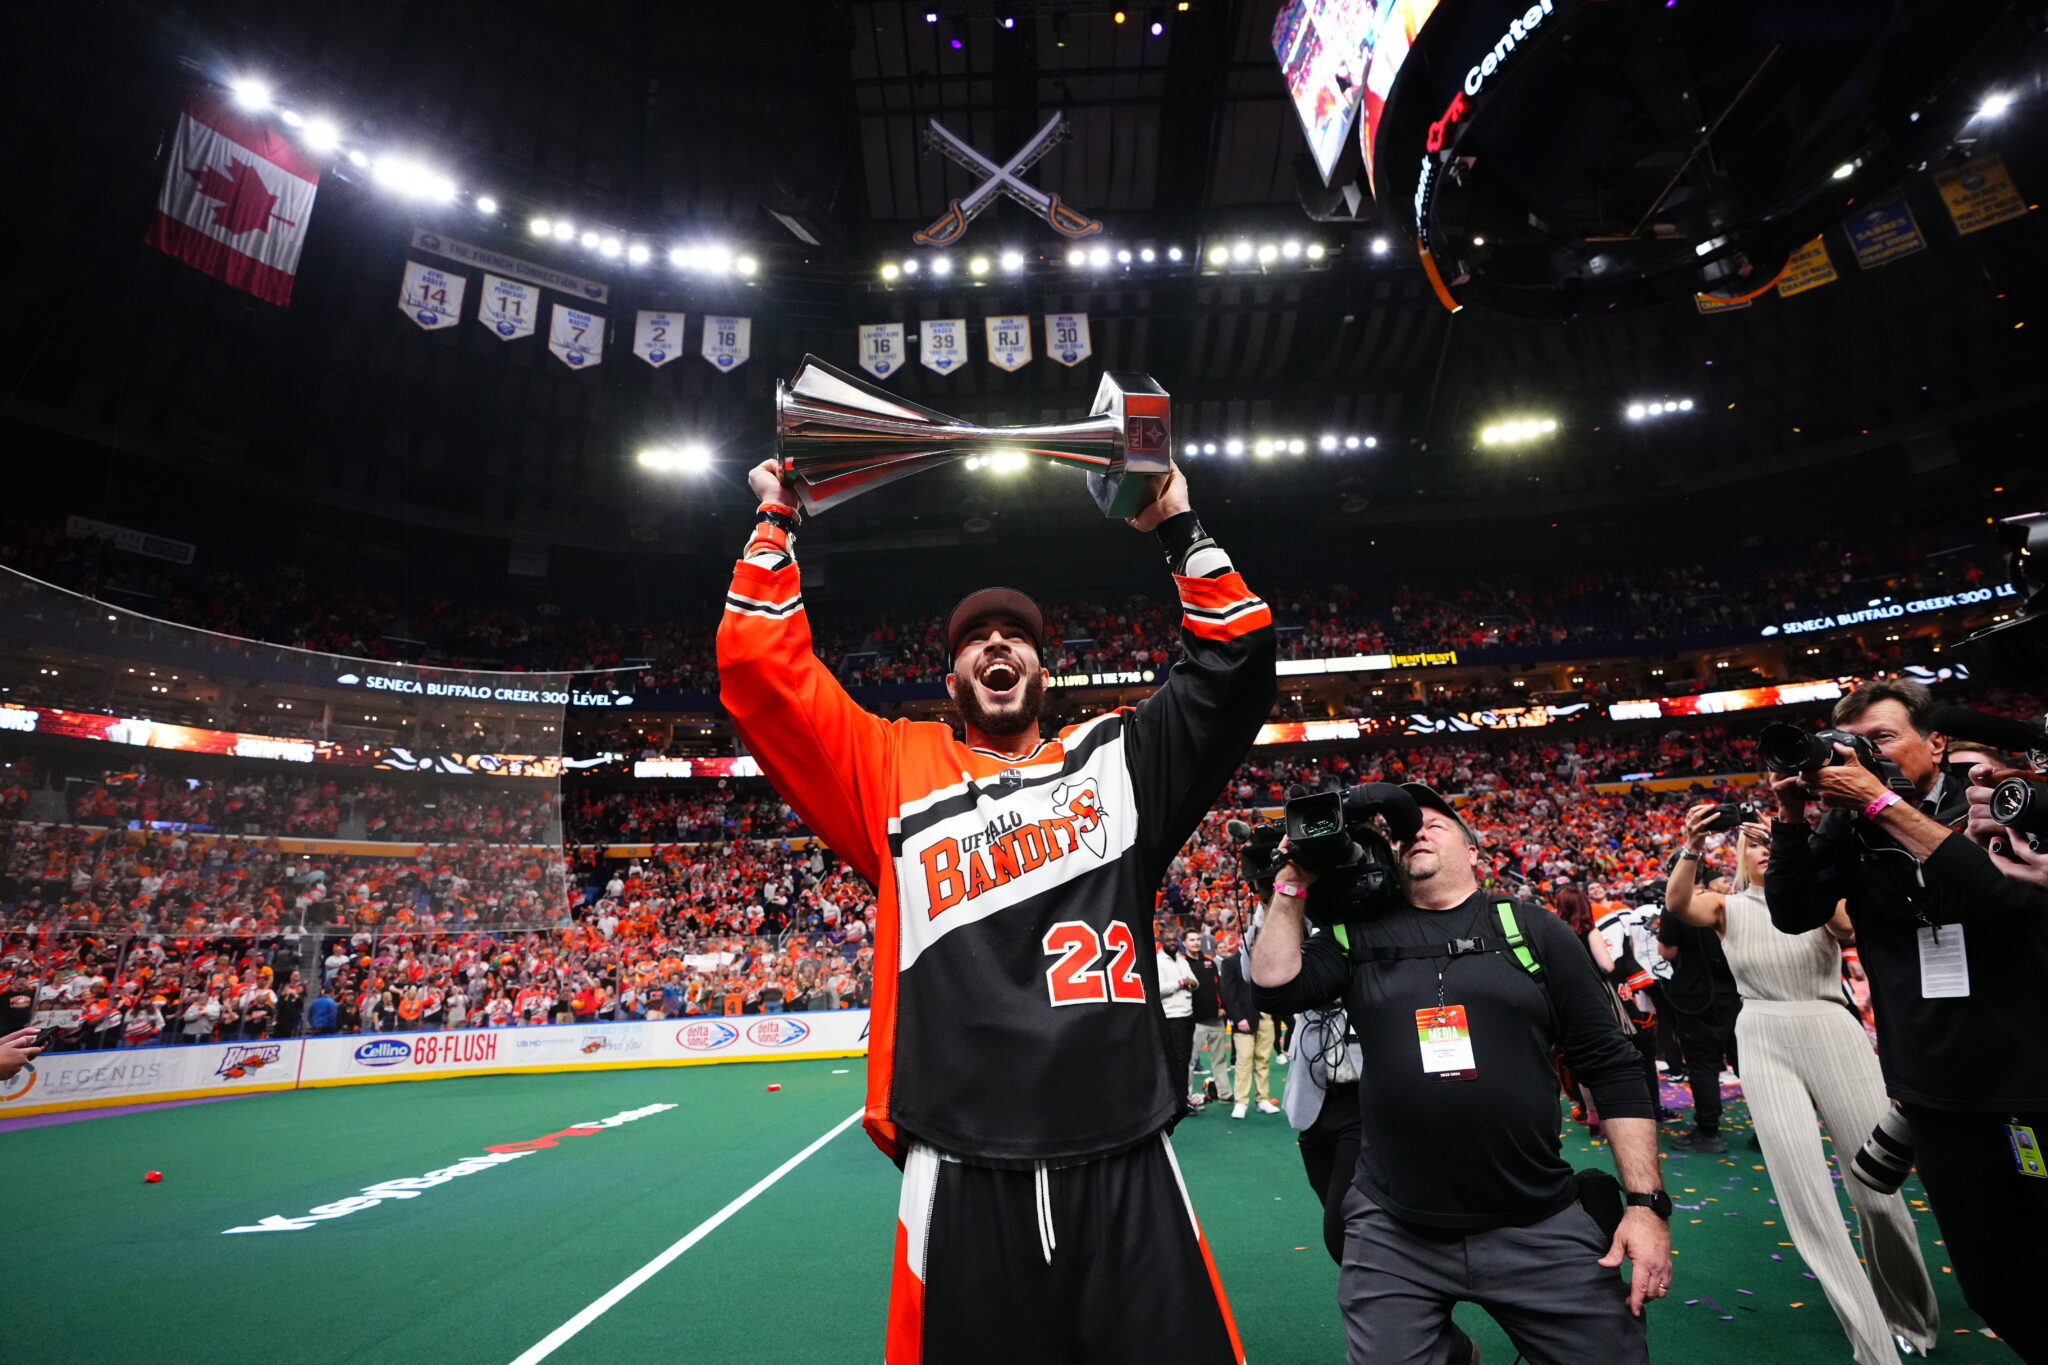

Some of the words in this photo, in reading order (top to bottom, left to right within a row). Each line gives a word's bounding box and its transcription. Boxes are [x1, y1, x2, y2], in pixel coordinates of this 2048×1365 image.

[472, 251, 514, 272] FRENCH
[516, 264, 579, 290] CONNECTION
[418, 284, 447, 306] 14
[497, 296, 522, 317] 11
[571, 326, 586, 343] 7
[652, 326, 666, 343] 2
[717, 331, 736, 347] 18
[932, 334, 955, 350] 39
[998, 331, 1020, 346] RJ
[1056, 328, 1078, 344] 30
[872, 338, 891, 354] 16
[1783, 618, 1836, 635] SENECA
[1836, 604, 1905, 626] BUFFALO
[1906, 595, 1957, 614] CREEK
[1957, 587, 1992, 606] 300
[1064, 674, 1089, 687] LOVED
[1092, 674, 1102, 685] IN
[1102, 672, 1118, 684] THE
[1118, 671, 1141, 684] 716
[366, 675, 423, 695] SENECA
[426, 682, 492, 700] BUFFALO
[494, 687, 539, 703] CREEK
[541, 691, 569, 705] 300
[572, 692, 612, 706] LEVEL
[1000, 768, 1021, 778] NLL
[920, 789, 1099, 922] BANDITS
[1042, 919, 1147, 1008] 22
[687, 1025, 708, 1037] delta
[757, 1021, 779, 1033] delta
[1428, 1025, 1460, 1041] MEDIA
[687, 1037, 709, 1047] sonic
[757, 1033, 779, 1043] sonic
[360, 1043, 409, 1057] Cellino
[414, 1033, 498, 1065] 68-FLUSH
[43, 1063, 161, 1088] LEGENDS
